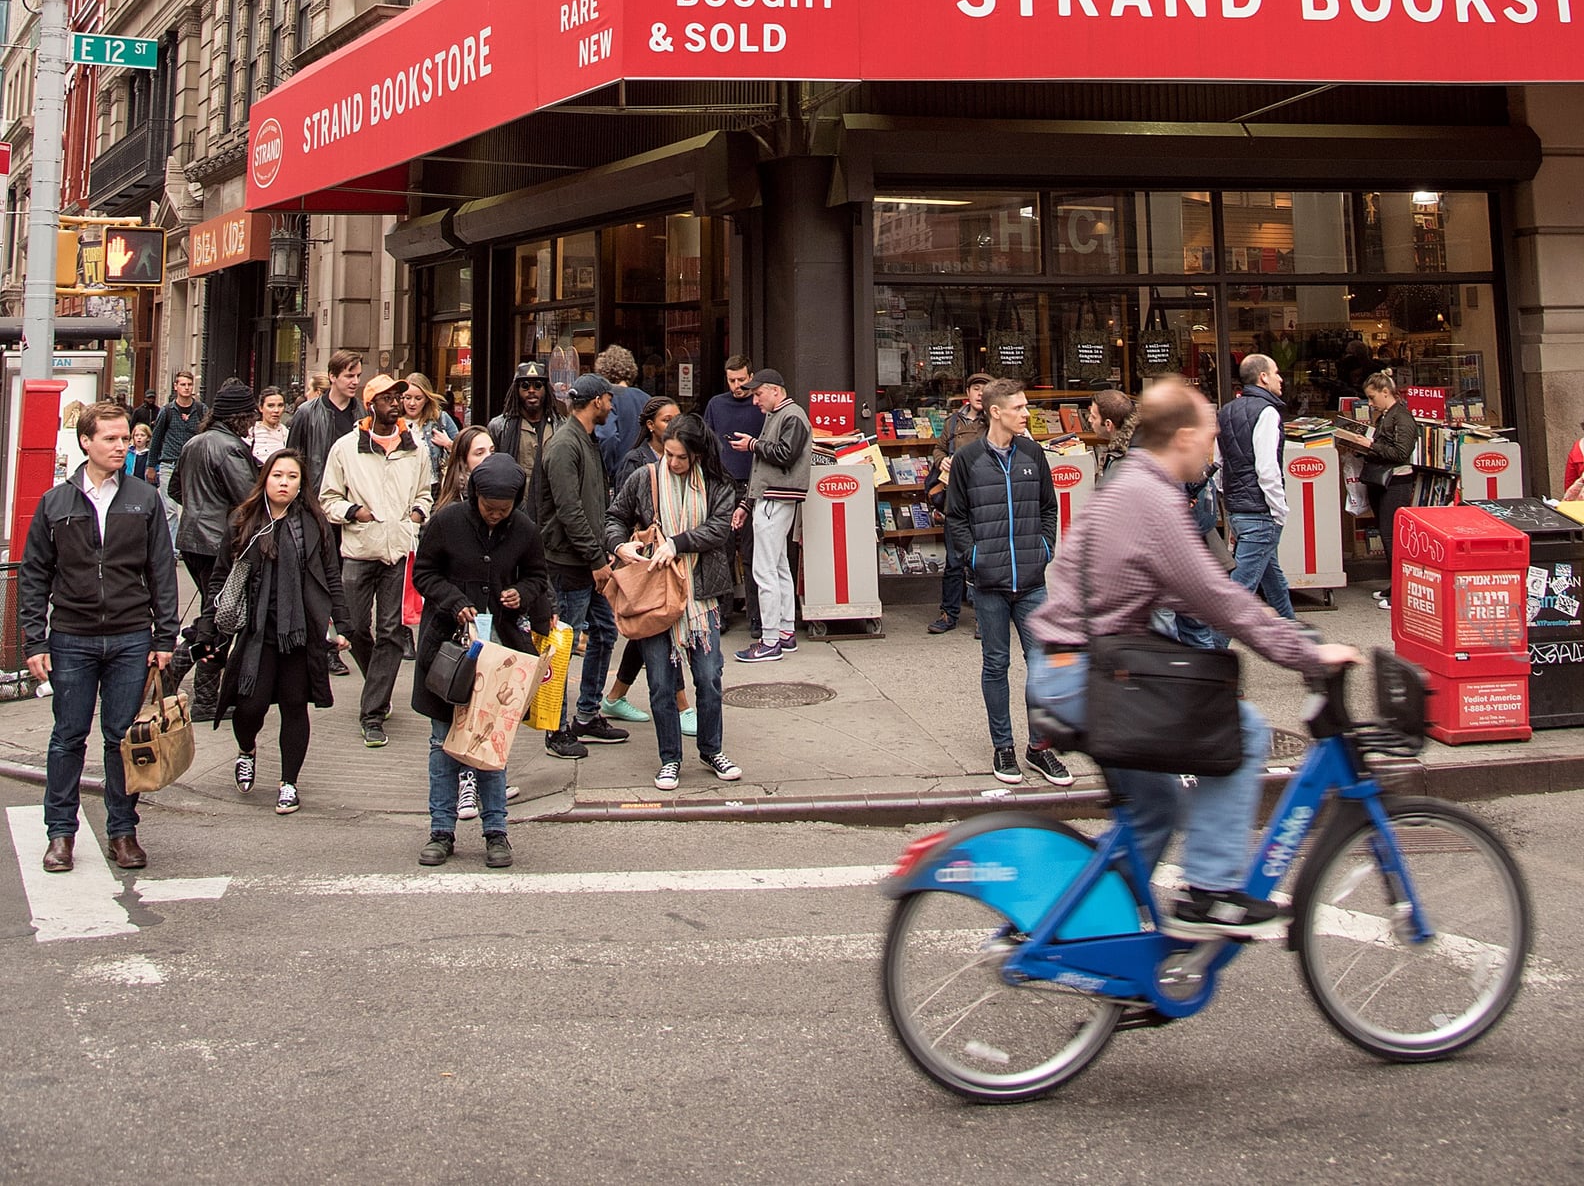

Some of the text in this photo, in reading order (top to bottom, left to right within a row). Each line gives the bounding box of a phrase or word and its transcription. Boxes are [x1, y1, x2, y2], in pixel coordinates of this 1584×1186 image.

[648, 22, 787, 52] & SOLD
[81, 38, 148, 63] E 12 ST
[578, 28, 614, 68] NEW
[303, 25, 492, 153] STRAND BOOKSTORE
[254, 138, 281, 167] STRAND
[52, 358, 72, 367] TAN
[810, 393, 854, 403] SPECIAL
[1407, 388, 1444, 398] SPECIAL
[1290, 463, 1324, 473] STRAND
[1475, 458, 1507, 467] STRAND
[819, 481, 857, 492] STRAND
[1407, 595, 1436, 615] FREE!
[1463, 694, 1522, 704] Yediot America
[1463, 702, 1522, 713] 1-888-9-YEDIOT
